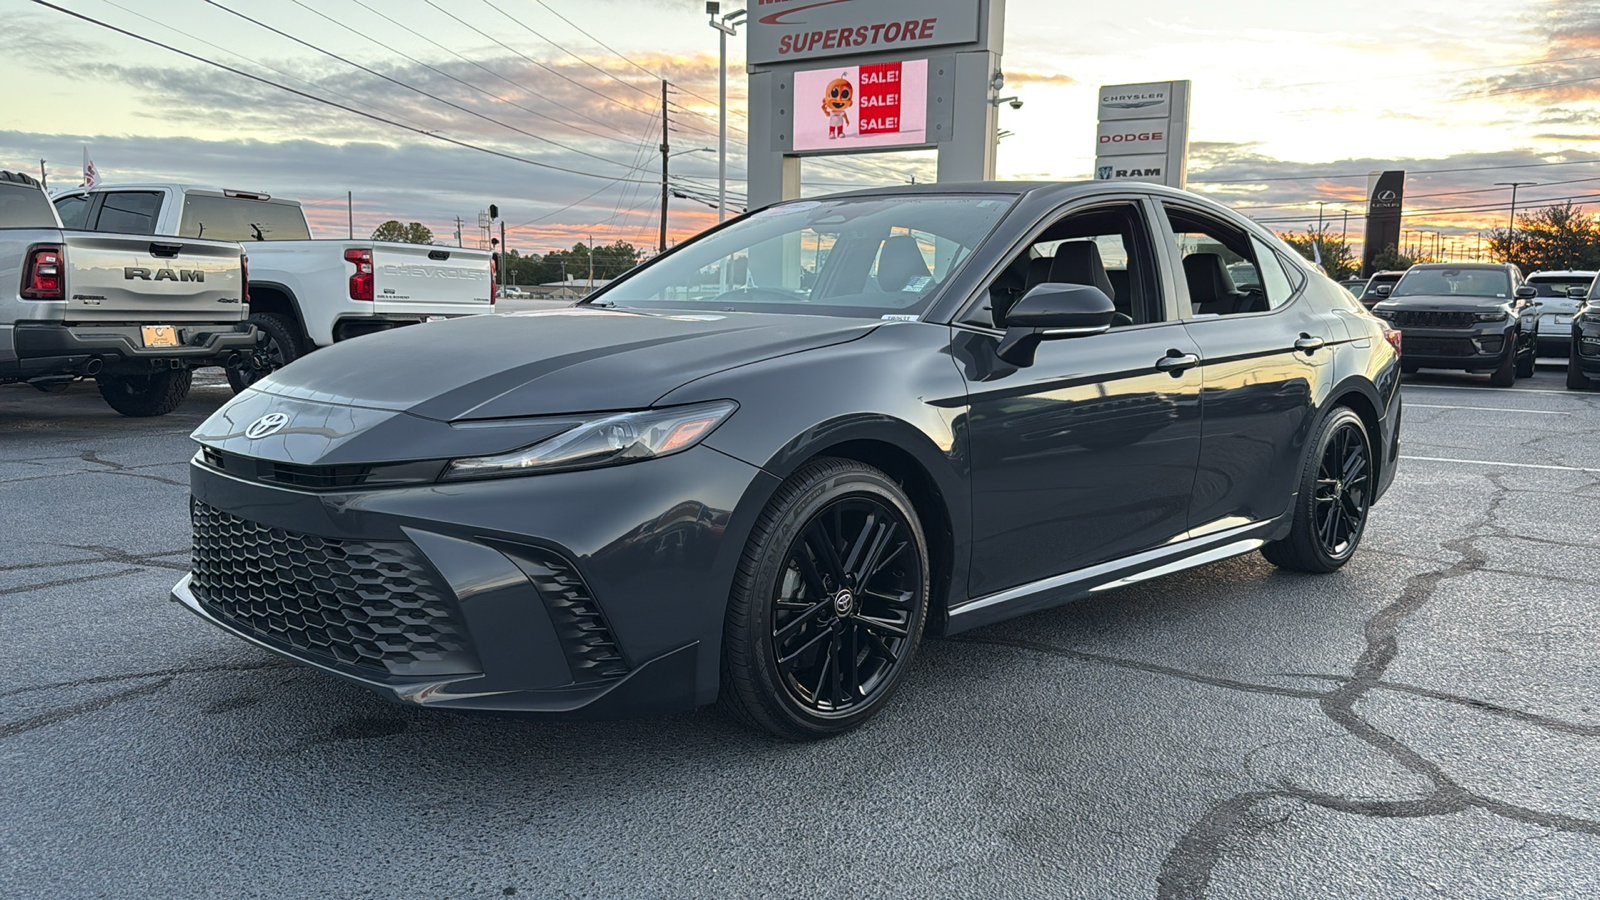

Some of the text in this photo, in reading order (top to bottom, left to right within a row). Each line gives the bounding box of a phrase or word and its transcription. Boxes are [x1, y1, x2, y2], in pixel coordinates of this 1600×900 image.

[778, 18, 938, 54] SUPERSTORE
[860, 71, 899, 85] SALE!
[860, 94, 898, 108] SALE!
[1102, 93, 1164, 102] CHRYSLER
[859, 117, 898, 131] SALE!
[1099, 132, 1163, 144] DODGE
[1115, 168, 1161, 178] RAM
[123, 267, 205, 283] RAM
[383, 264, 488, 281] CHEVROLET
